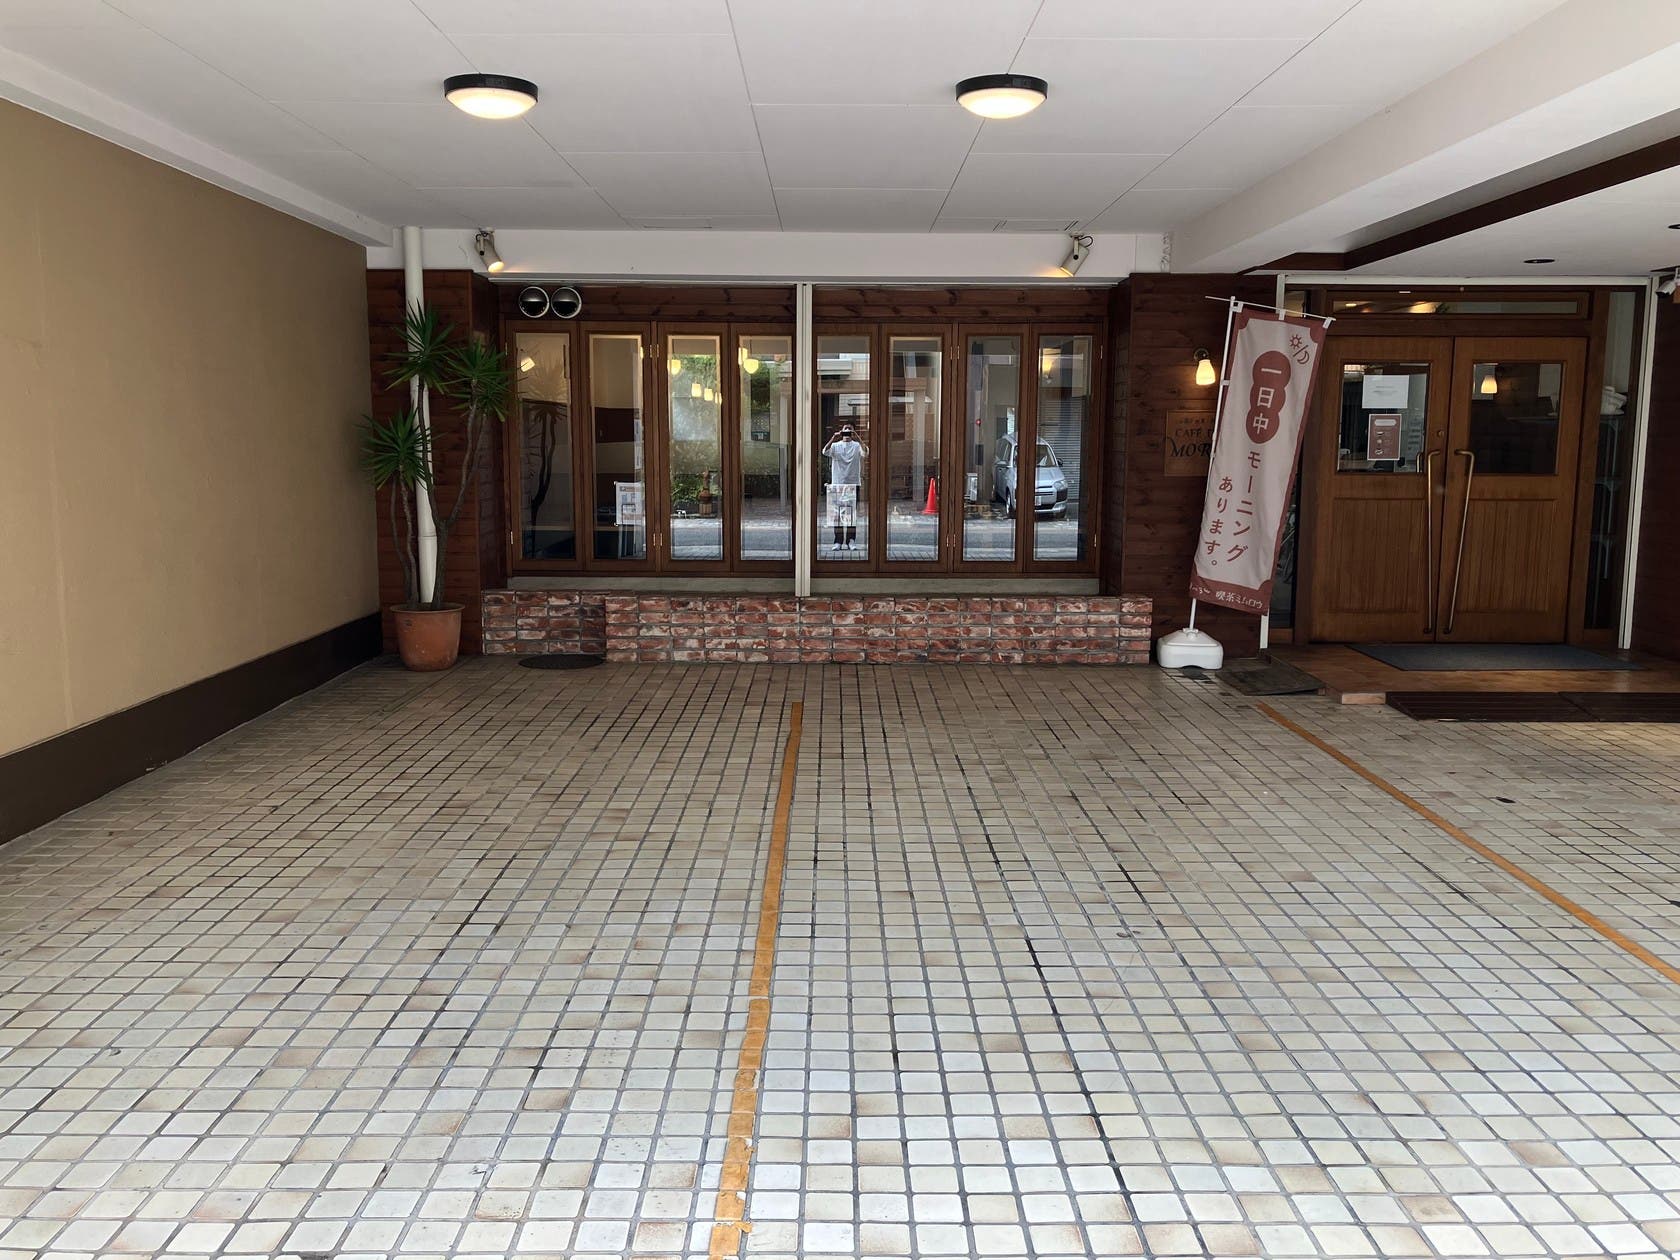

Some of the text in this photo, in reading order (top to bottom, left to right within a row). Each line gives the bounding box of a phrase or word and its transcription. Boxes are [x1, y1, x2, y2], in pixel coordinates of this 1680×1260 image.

[1204, 476, 1233, 566] あります。
[1227, 367, 1282, 562] 一日中 モーニング
